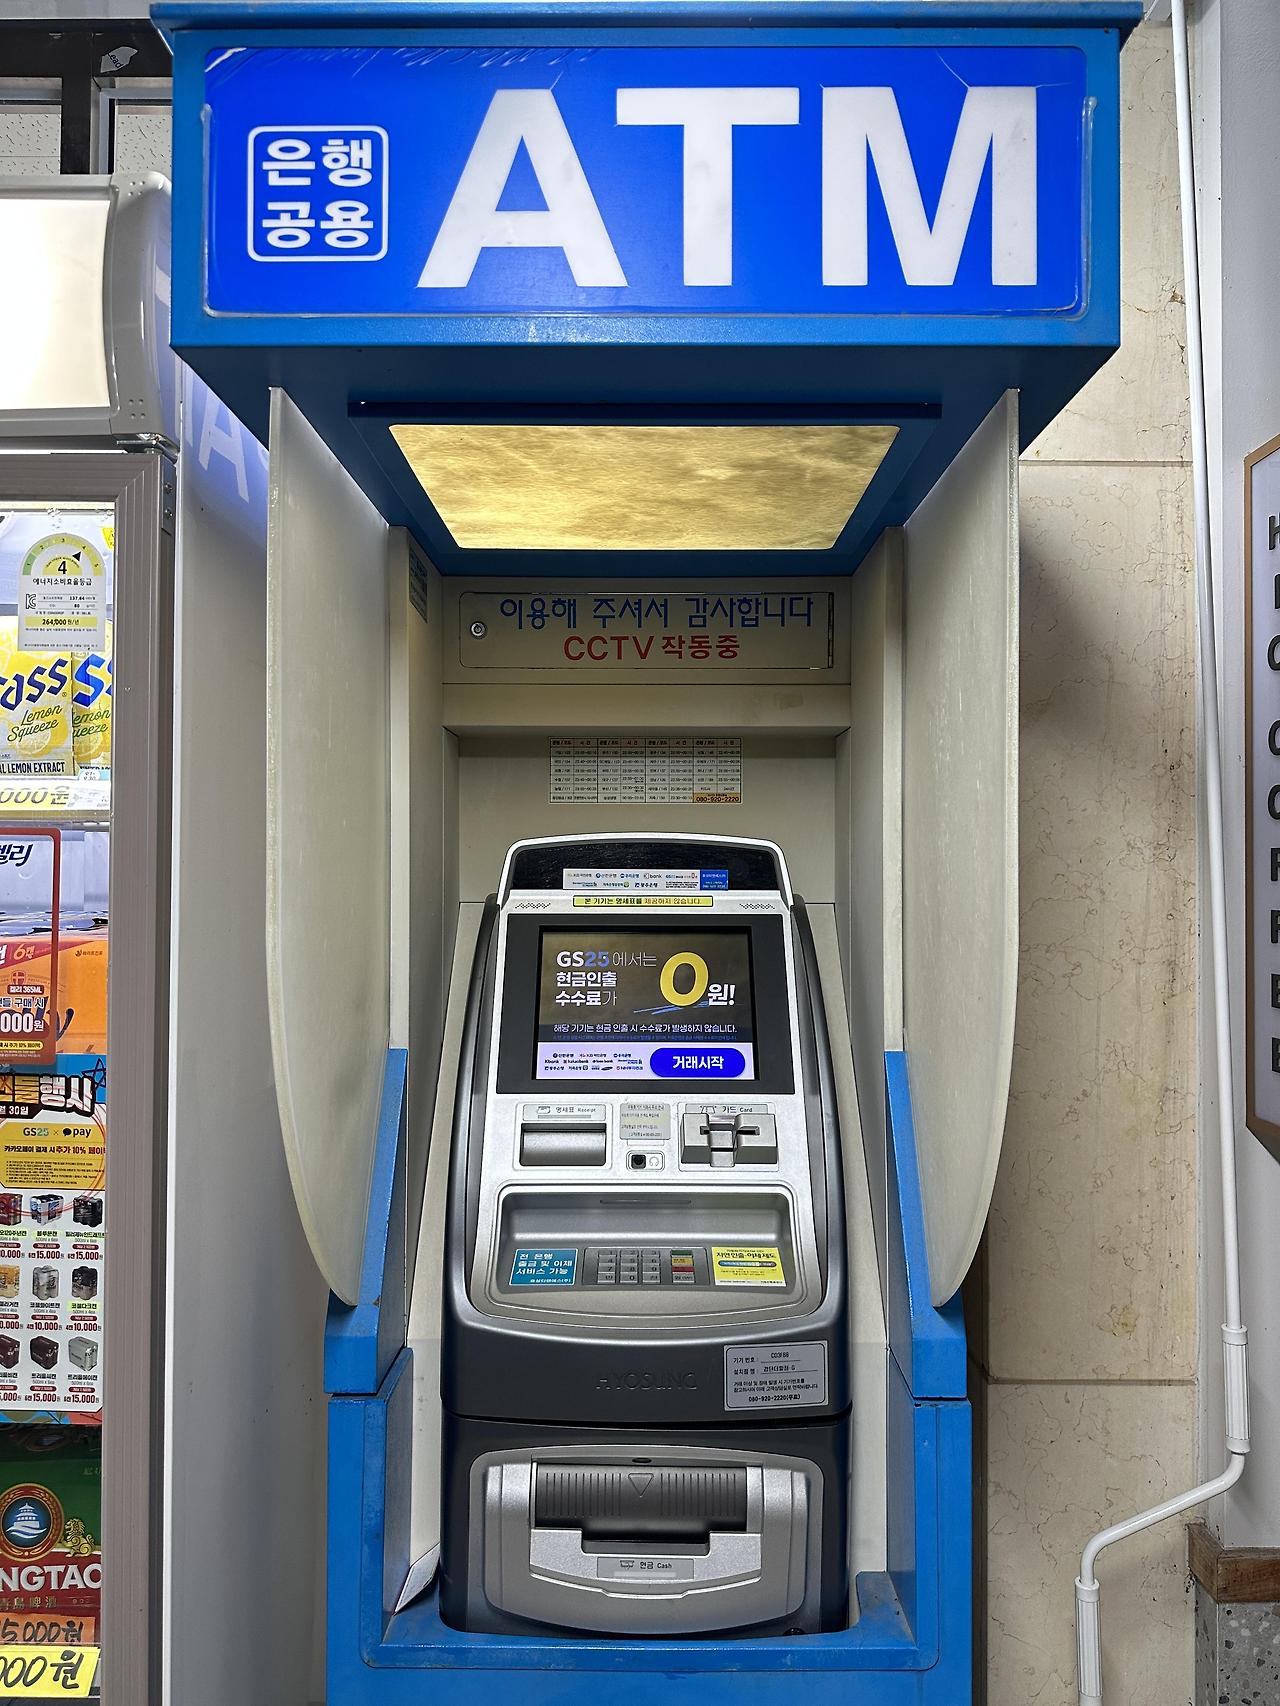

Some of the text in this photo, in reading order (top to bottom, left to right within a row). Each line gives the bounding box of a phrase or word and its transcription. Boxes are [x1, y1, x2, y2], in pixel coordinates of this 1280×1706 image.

[262, 139, 372, 187] 은행
[417, 86, 1038, 288] ATM
[262, 200, 374, 249] 공용
[58, 561, 67, 574] 4
[33, 578, 92, 586] 에너지소비효율등급
[500, 596, 815, 630] 이용해 주셔서 감사합니다
[563, 634, 741, 661] CCTV 작동중
[21, 704, 62, 727] Lemon
[7, 719, 59, 743] Squeeze
[8, 763, 32, 774] LEMON
[34, 762, 65, 773] EXTRACT
[556, 951, 657, 968] GS25 에서는
[556, 972, 618, 988] 현금인출
[14, 998, 33, 1008] 구매
[35, 997, 44, 1008] 시
[556, 991, 617, 1006] 수수료가
[554, 1024, 738, 1032] 해당 기기는 현금 인출 시 수수료가 발생하지 않습니다.
[672, 1056, 724, 1070] 거래시작
[8, 1105, 28, 1116] 30일
[23, 1128, 92, 1138] GS25 pay
[56, 1146, 71, 1154] 추가
